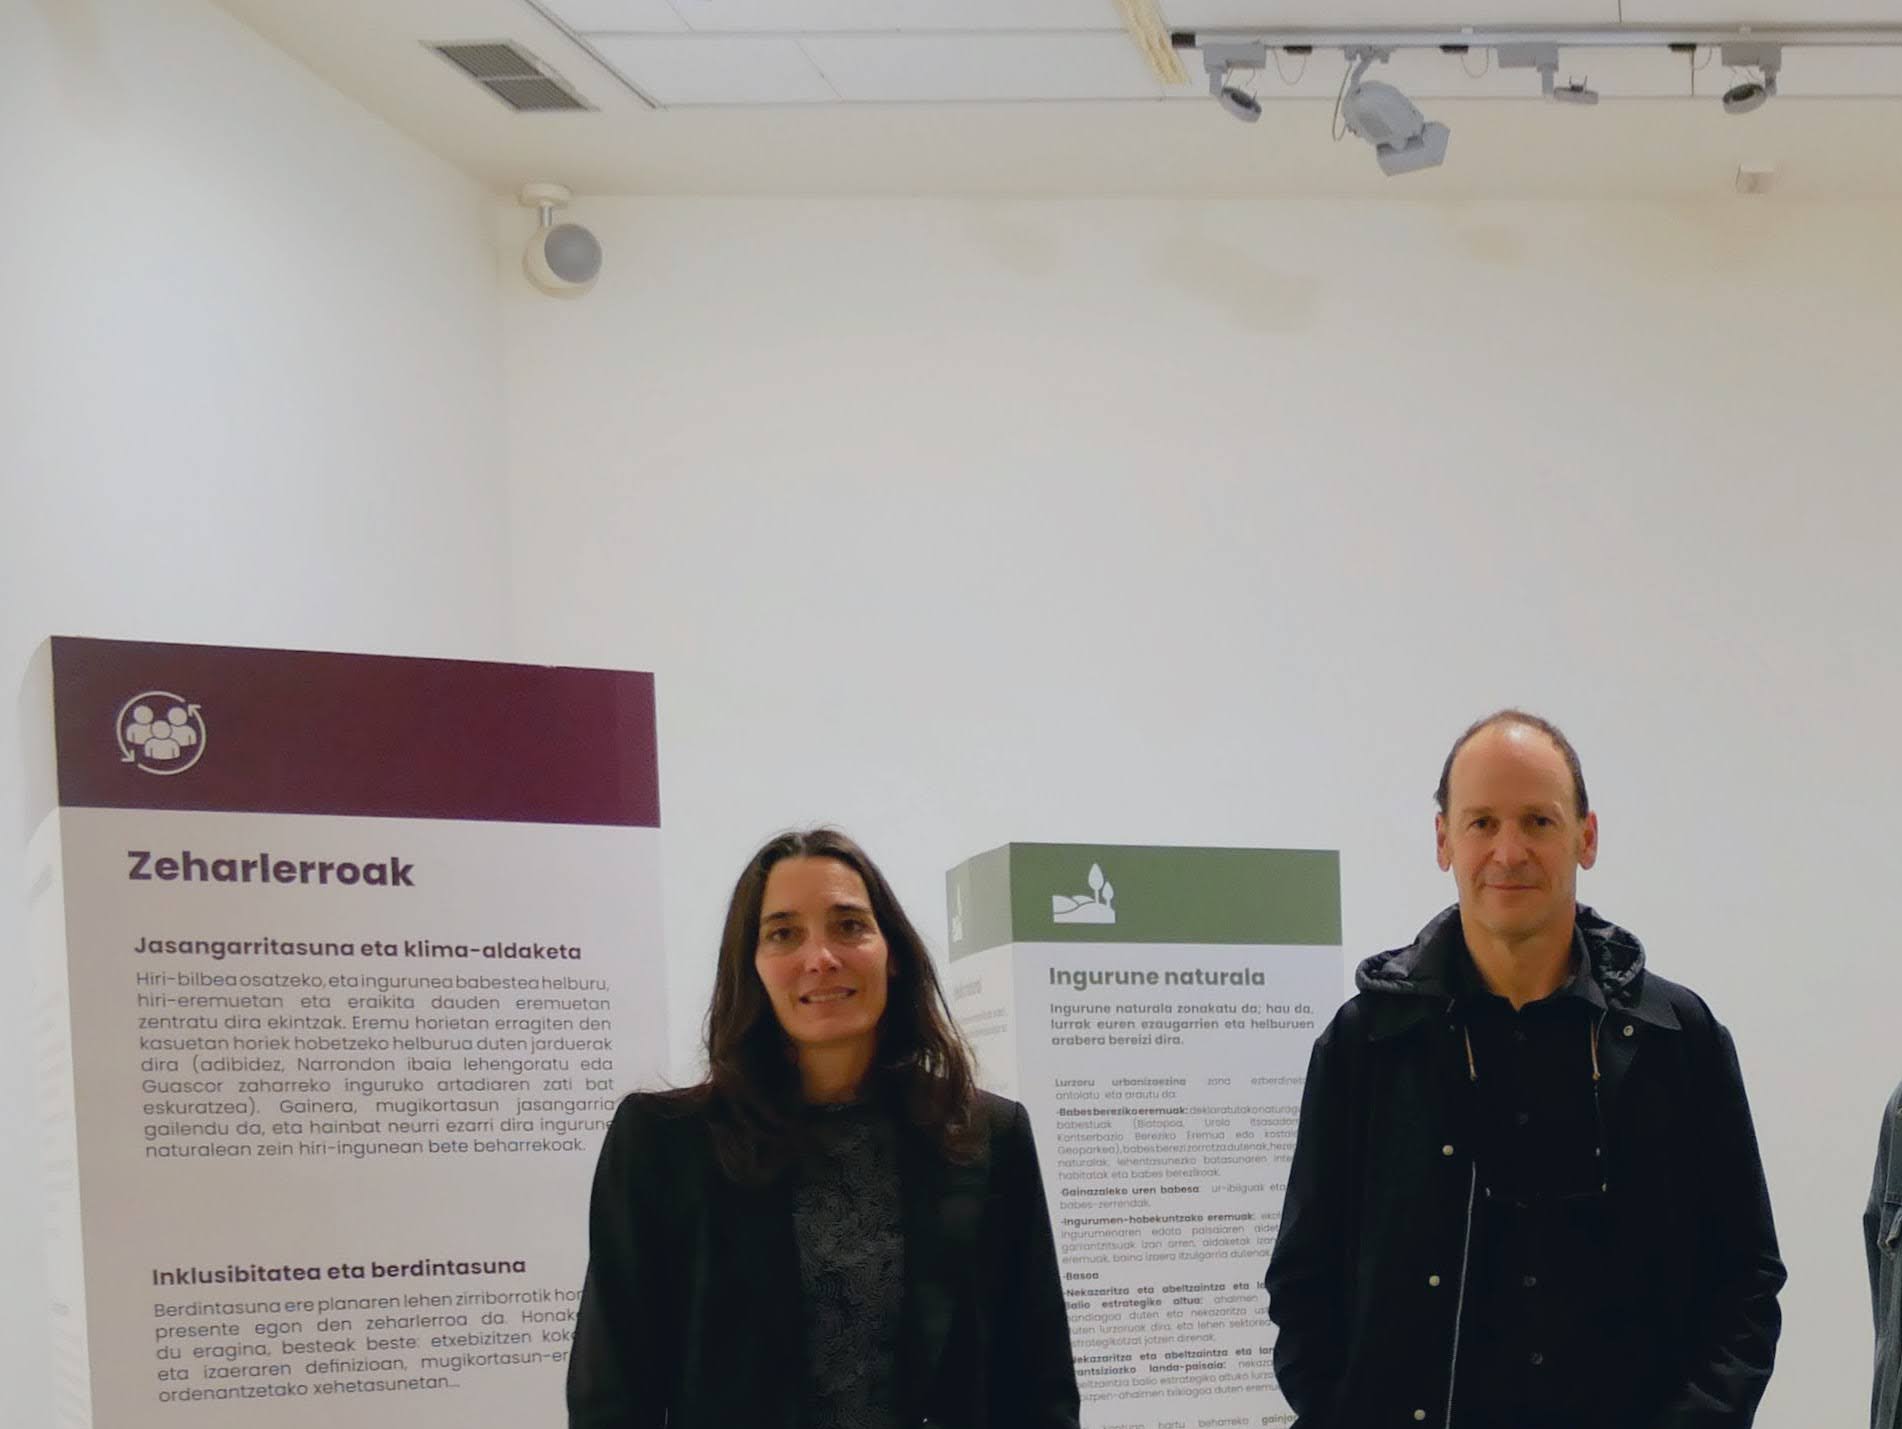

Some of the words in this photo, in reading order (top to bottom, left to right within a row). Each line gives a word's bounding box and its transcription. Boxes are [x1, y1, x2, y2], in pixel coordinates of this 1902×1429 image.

[128, 850, 414, 886] Zeharlerroak
[134, 937, 354, 960] Jasangarritasuna
[360, 940, 398, 957] eta
[404, 939, 581, 960] klima-aldaketa
[136, 971, 237, 987] Hiri-bilbea
[239, 973, 326, 988] osatzeko,
[328, 974, 359, 988] eta
[361, 974, 453, 993] ingurunea
[456, 975, 539, 990] babestea
[542, 976, 609, 992] helburu,
[1049, 967, 1159, 991] Ingurune
[1164, 968, 1265, 986] naturala
[1050, 1003, 1111, 1017] Ingurune
[1116, 1003, 1172, 1014] naturala
[1266, 1003, 1290, 1014] hau
[1051, 1018, 1091, 1029] lurrak
[1097, 1021, 1135, 1029] euren
[1141, 1018, 1219, 1033] ezaugarrien
[1224, 1019, 1245, 1029] eta
[1251, 1018, 1314, 1029] helburuen
[1051, 1035, 1106, 1046] arabera
[1108, 1034, 1152, 1045] bereizi
[1154, 1033, 1184, 1045] dira.
[146, 1142, 252, 1158] naturalean
[257, 1142, 293, 1156] zein
[299, 1140, 423, 1159] hiri-ingunean
[428, 1139, 469, 1153] bete
[473, 1138, 586, 1153] beharrekoak.
[153, 1264, 321, 1285] Inklusibitatea
[327, 1263, 365, 1280] eta
[371, 1258, 526, 1278] berdintasuna
[158, 1382, 308, 1402] ordenantzetako
